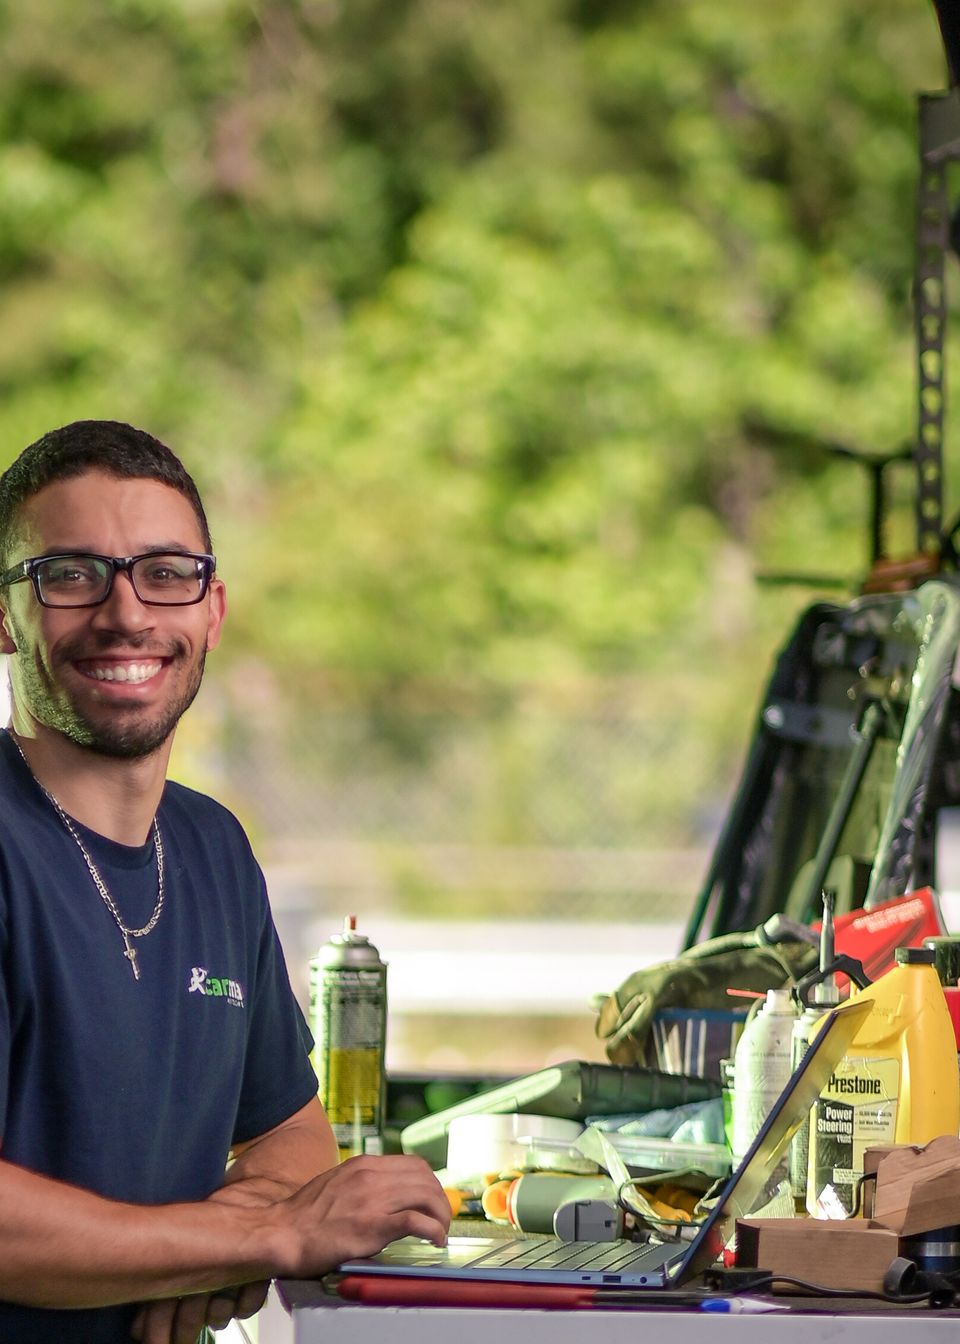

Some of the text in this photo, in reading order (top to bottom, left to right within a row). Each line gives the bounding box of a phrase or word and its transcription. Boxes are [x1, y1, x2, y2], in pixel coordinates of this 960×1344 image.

[827, 1073, 881, 1094] Prestone
[825, 1106, 853, 1120] Power
[817, 1119, 853, 1134] Steering
